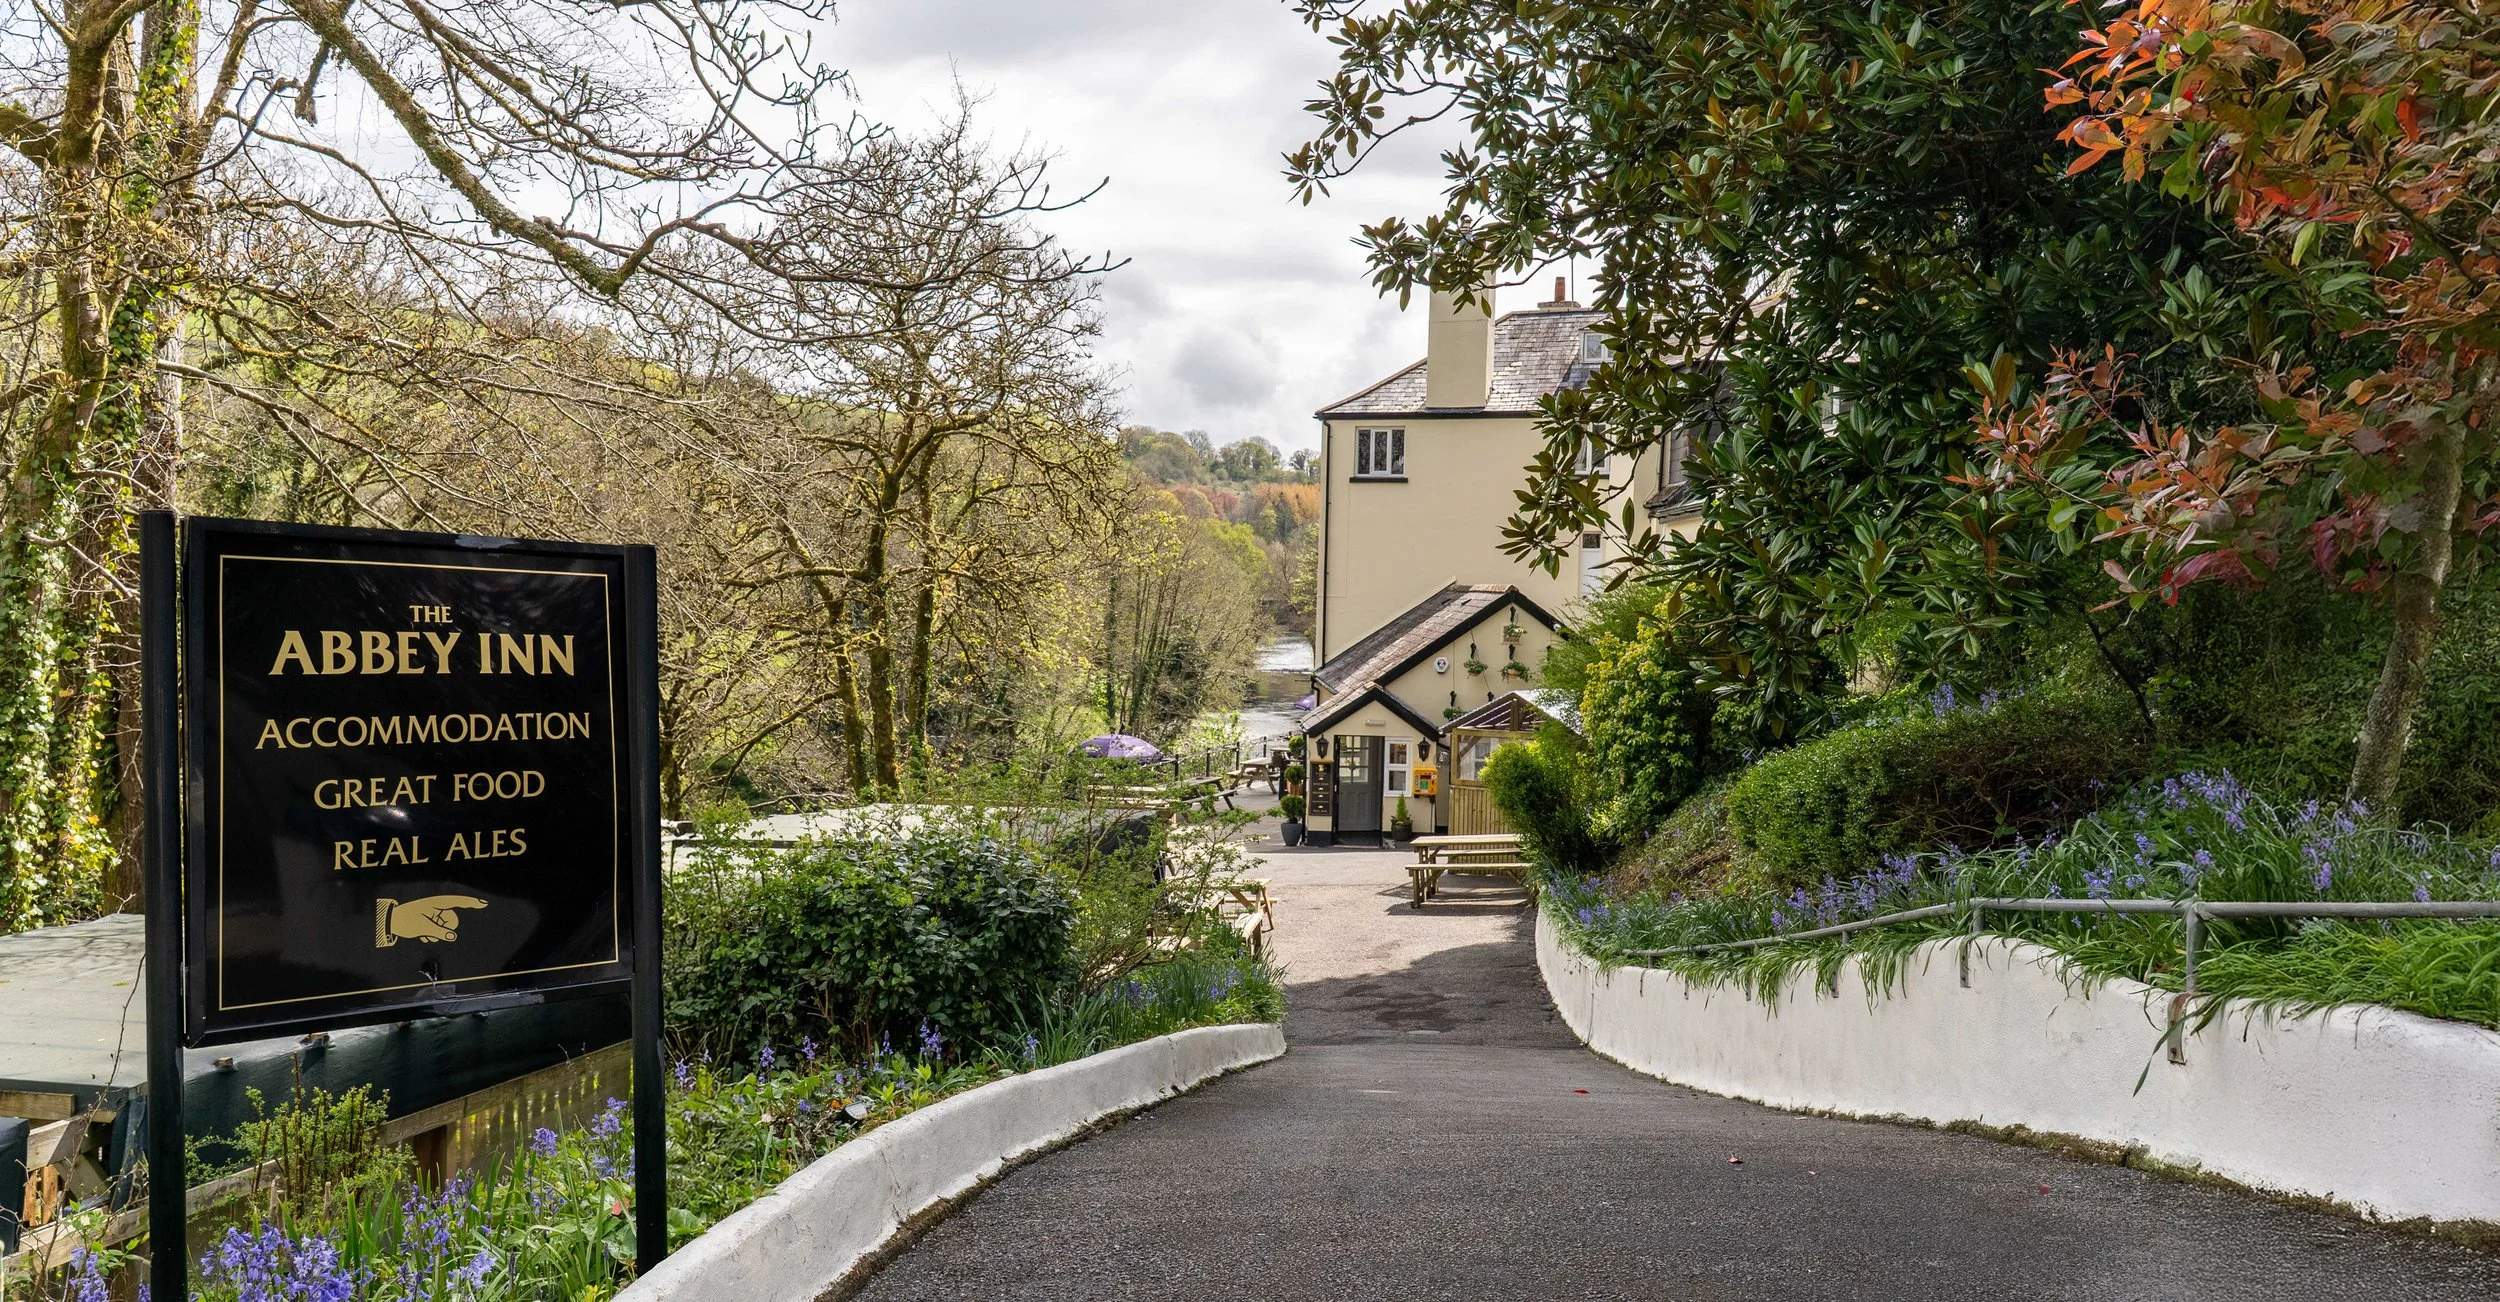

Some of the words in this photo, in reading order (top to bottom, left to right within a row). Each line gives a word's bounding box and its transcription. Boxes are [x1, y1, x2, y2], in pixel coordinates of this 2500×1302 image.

[410, 605, 453, 624] THE
[269, 631, 460, 675] ABBEY
[479, 632, 575, 676] INN
[255, 712, 590, 750] ACCOMMODATION
[314, 775, 437, 809] GREAT
[453, 770, 545, 801] FOOD
[333, 836, 429, 870] REAL
[445, 828, 527, 861] ALES
